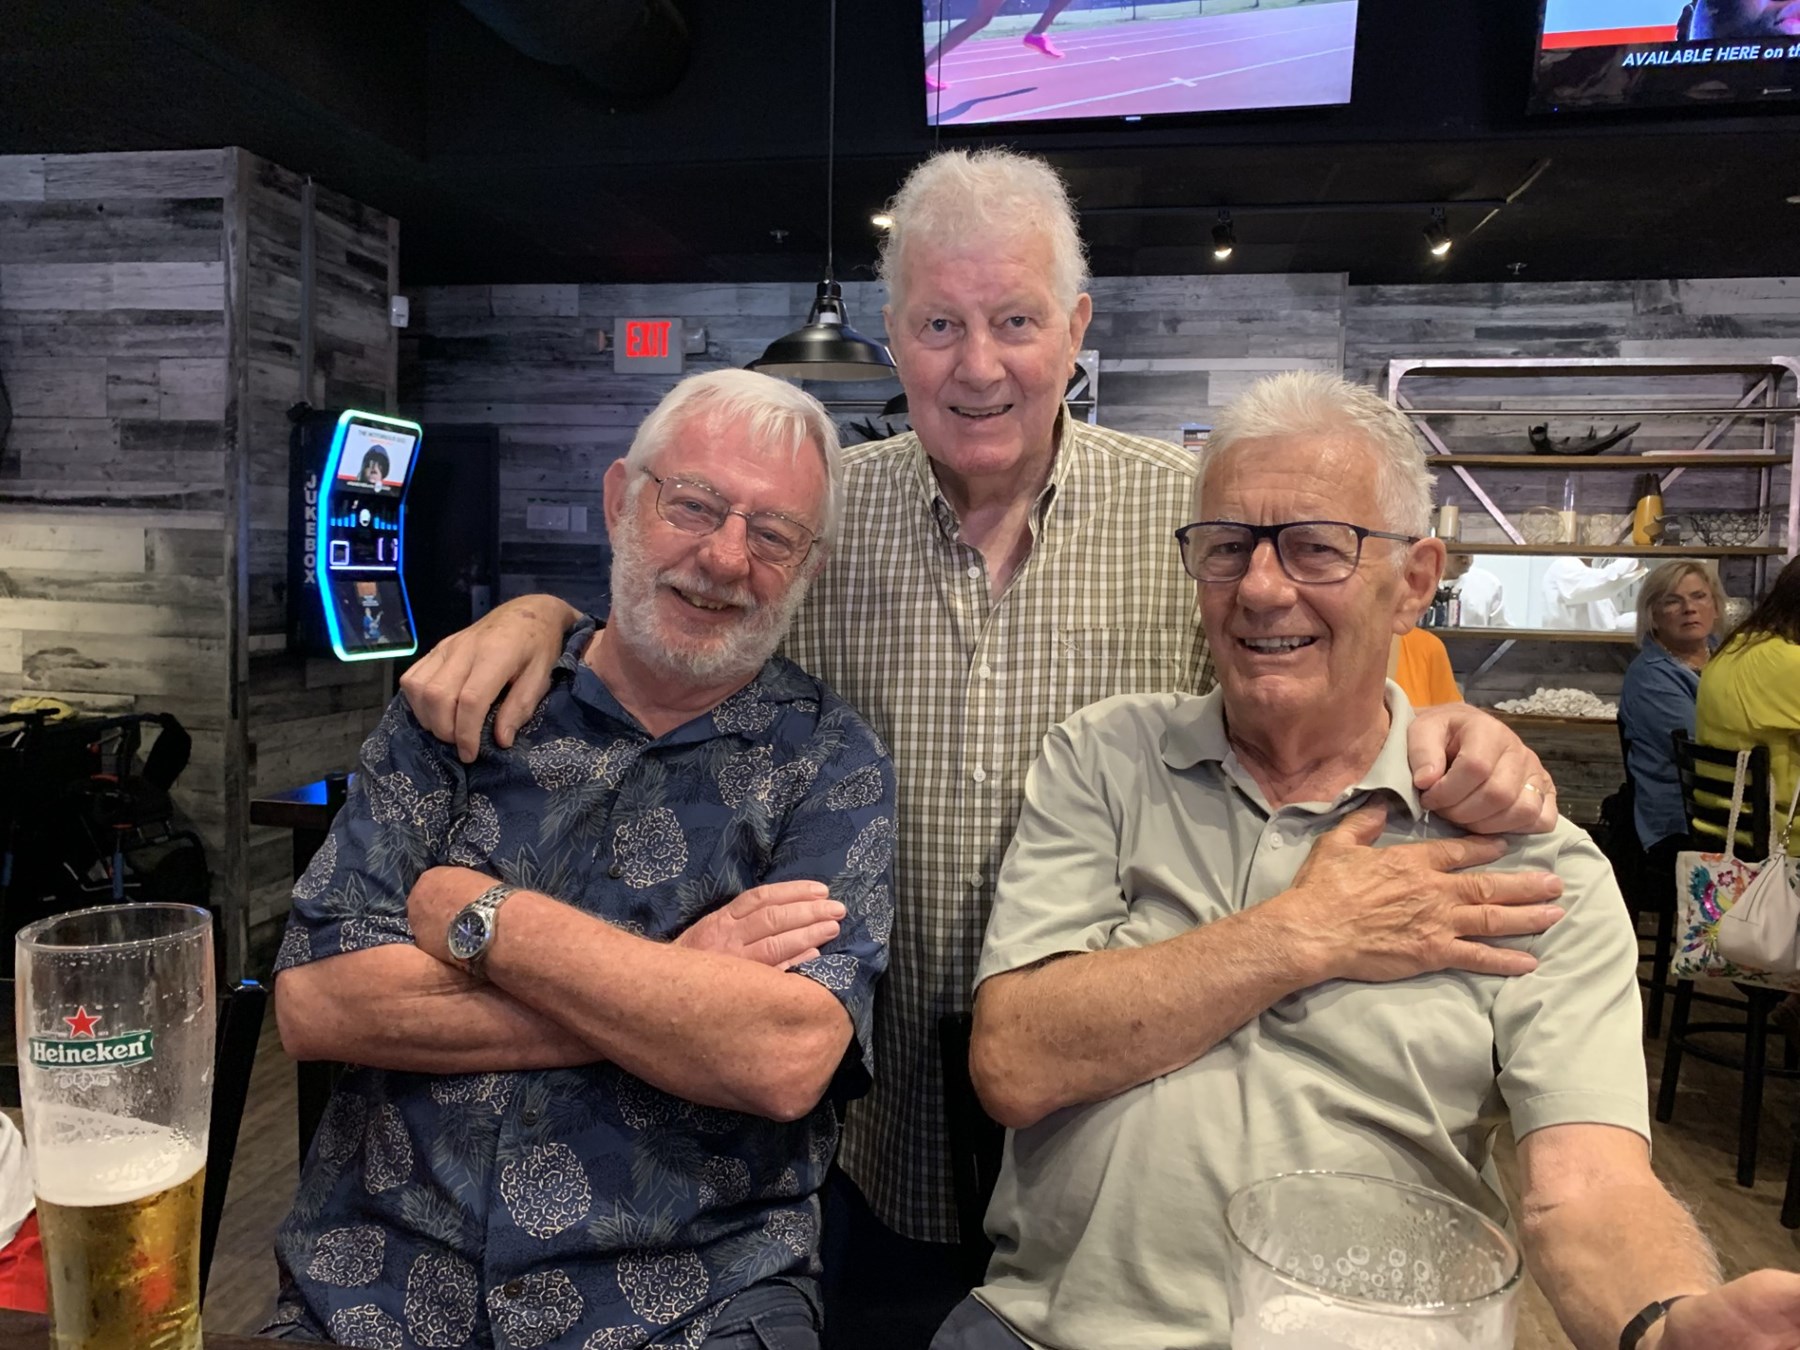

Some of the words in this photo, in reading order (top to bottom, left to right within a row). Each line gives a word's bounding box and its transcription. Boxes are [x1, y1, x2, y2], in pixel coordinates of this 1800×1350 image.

[1622, 48, 1713, 67] AVAILABLE
[1716, 45, 1761, 61] HERE
[1764, 48, 1783, 59] on
[626, 321, 672, 357] EXIT
[304, 474, 317, 584] JUKEBOX
[33, 1035, 146, 1063] Heineken
